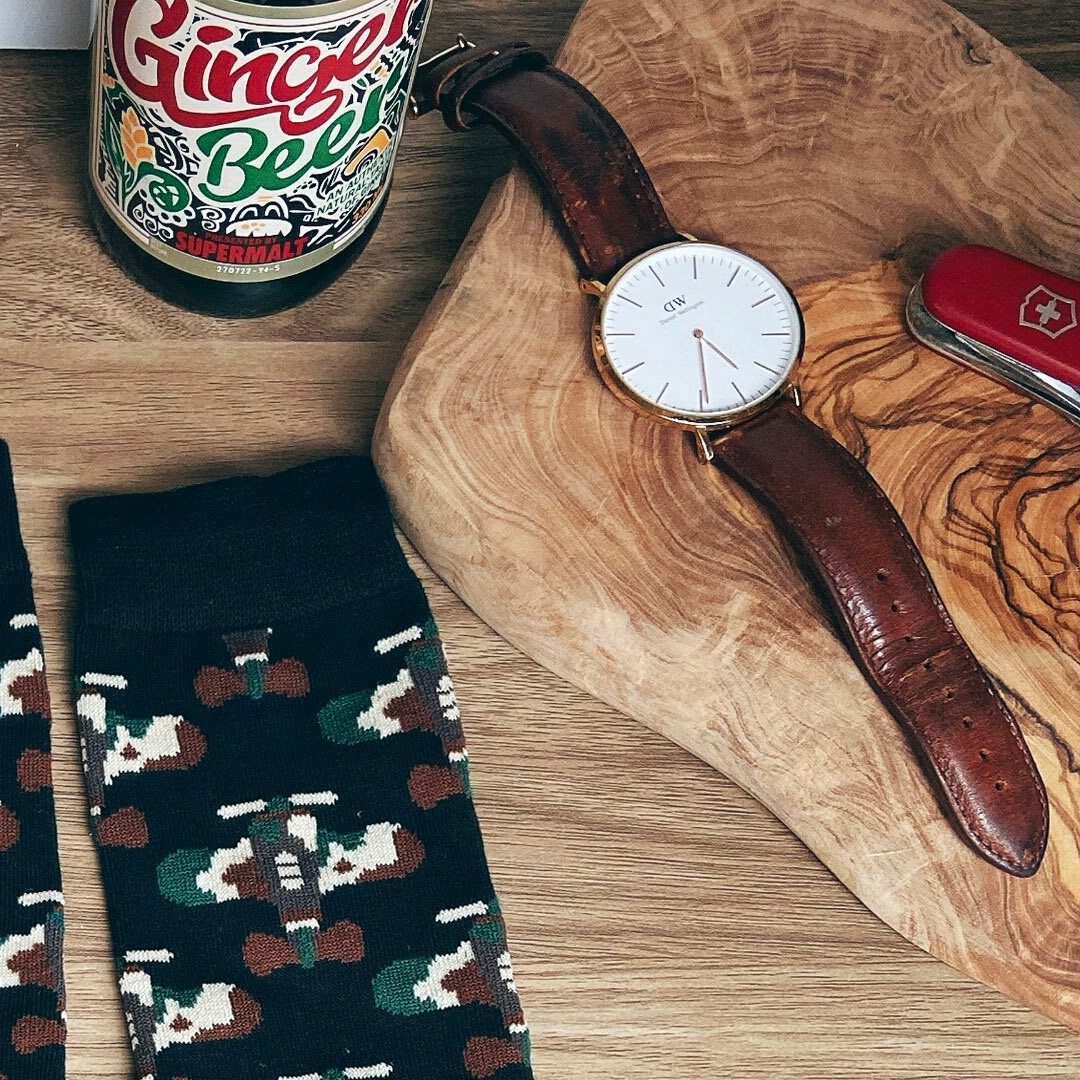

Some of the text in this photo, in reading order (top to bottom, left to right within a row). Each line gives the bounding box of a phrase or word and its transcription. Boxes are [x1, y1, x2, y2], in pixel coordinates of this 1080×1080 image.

[111, 0, 418, 136] Ginger
[197, 56, 405, 203] Beer
[317, 180, 367, 216] NATURAL
[175, 231, 309, 264] SUPERMALT
